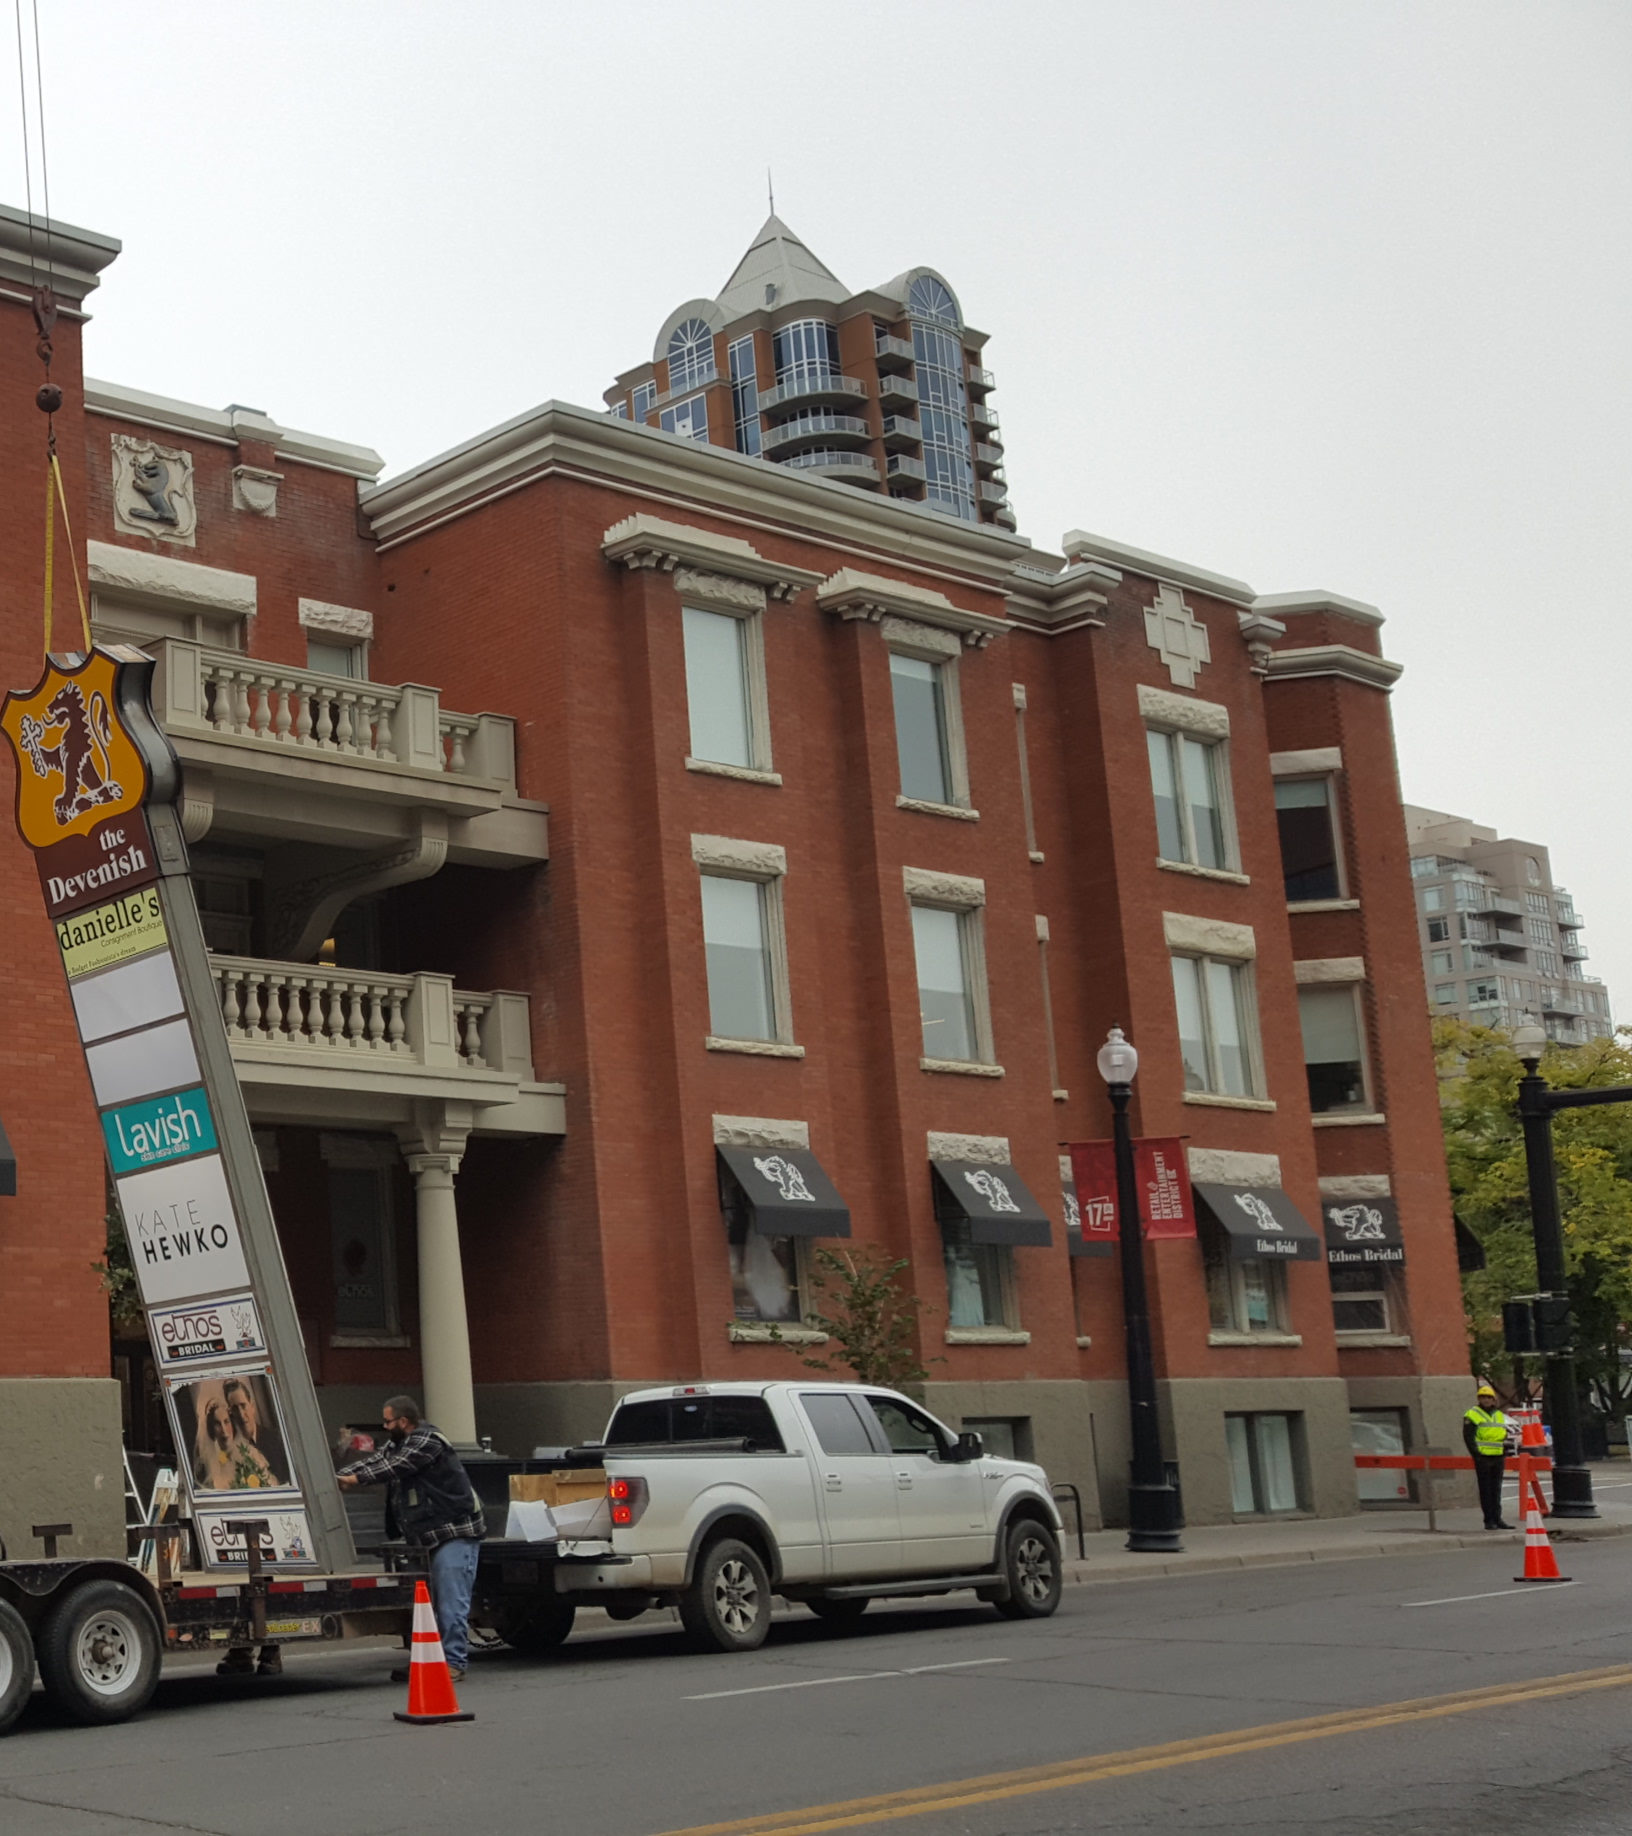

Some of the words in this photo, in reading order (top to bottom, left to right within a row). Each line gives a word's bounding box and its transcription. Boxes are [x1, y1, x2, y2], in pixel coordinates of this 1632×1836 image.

[99, 829, 126, 851] the
[47, 845, 147, 905] Devenish
[60, 891, 160, 951] danielle's
[101, 928, 136, 947] Consignment
[137, 920, 162, 934] Boutique
[115, 1096, 203, 1157] lavish
[1152, 1151, 1173, 1219] ENTERTAINMENT
[1168, 1181, 1183, 1218] DISTRICT
[135, 1200, 200, 1237] KATE
[1149, 1192, 1162, 1220] RETAIL
[142, 1224, 228, 1265] HEWKO
[1257, 1239, 1276, 1253] Ethos
[1276, 1240, 1298, 1254] Bridal
[1328, 1249, 1362, 1262] Ethos
[1364, 1248, 1403, 1261] Bridal
[178, 1343, 215, 1356] BRIDAL
